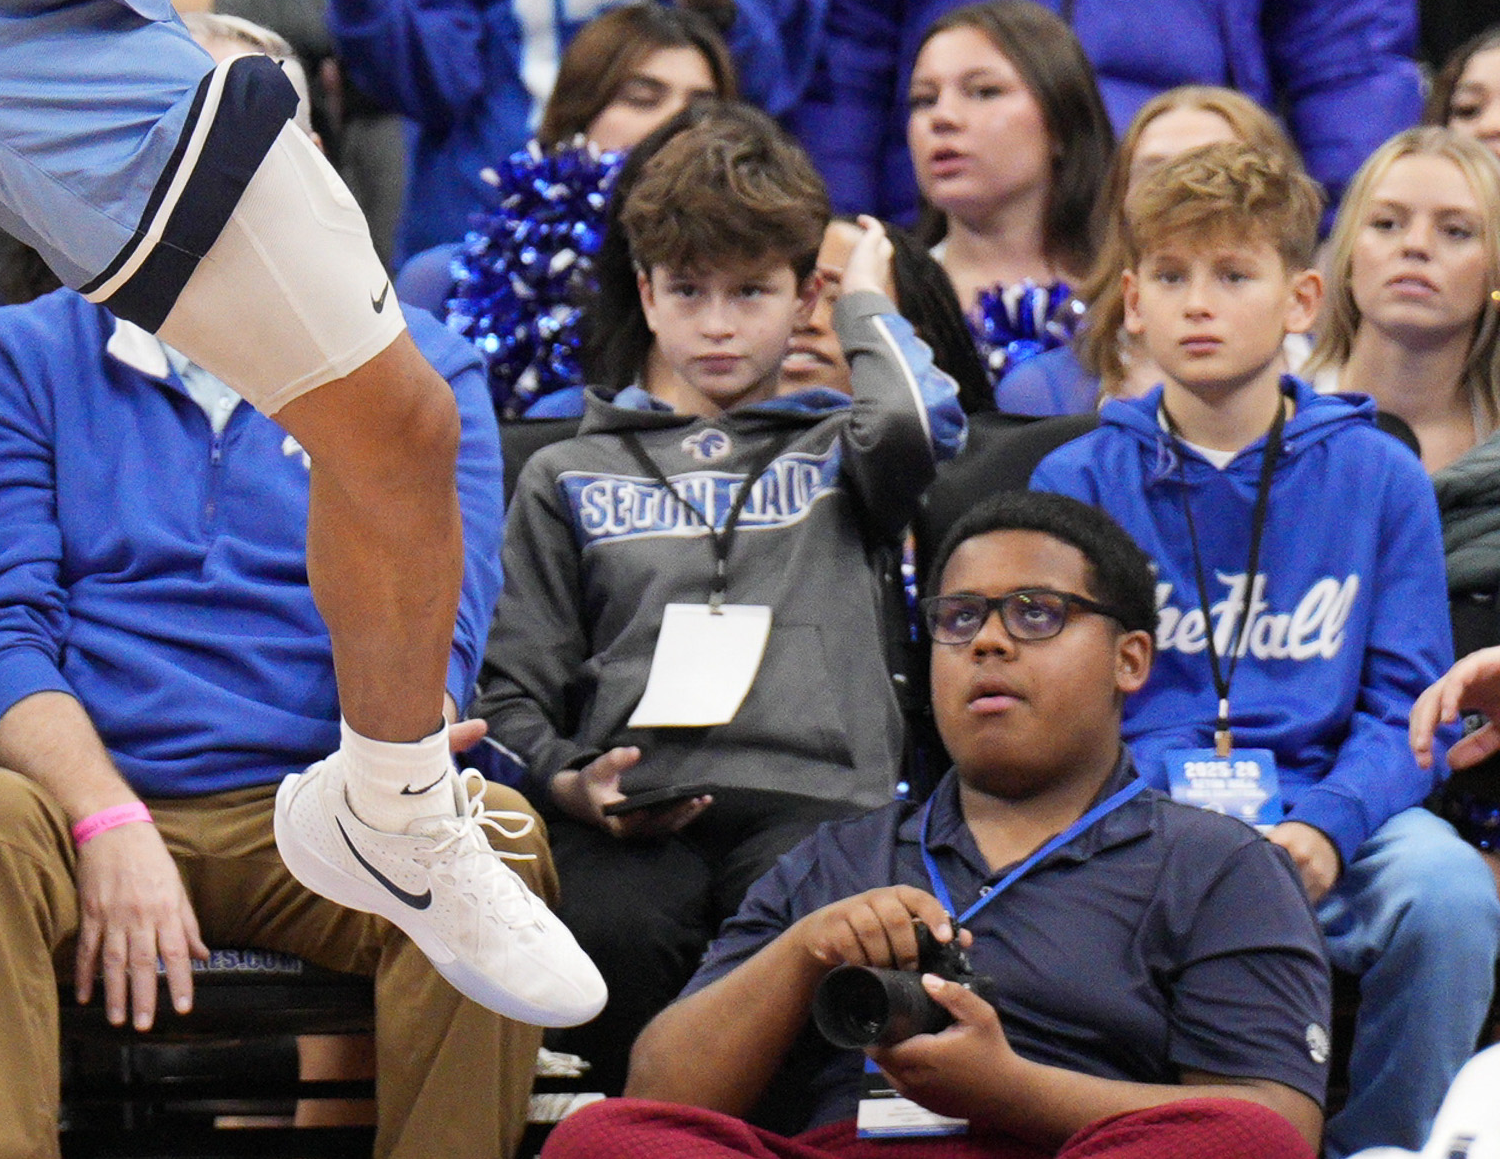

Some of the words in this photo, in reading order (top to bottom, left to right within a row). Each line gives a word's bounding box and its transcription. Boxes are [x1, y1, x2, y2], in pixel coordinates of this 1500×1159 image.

[581, 478, 715, 536] SETON
[728, 459, 821, 523] HALL
[1153, 563, 1209, 655] he
[1210, 568, 1360, 661] Hall
